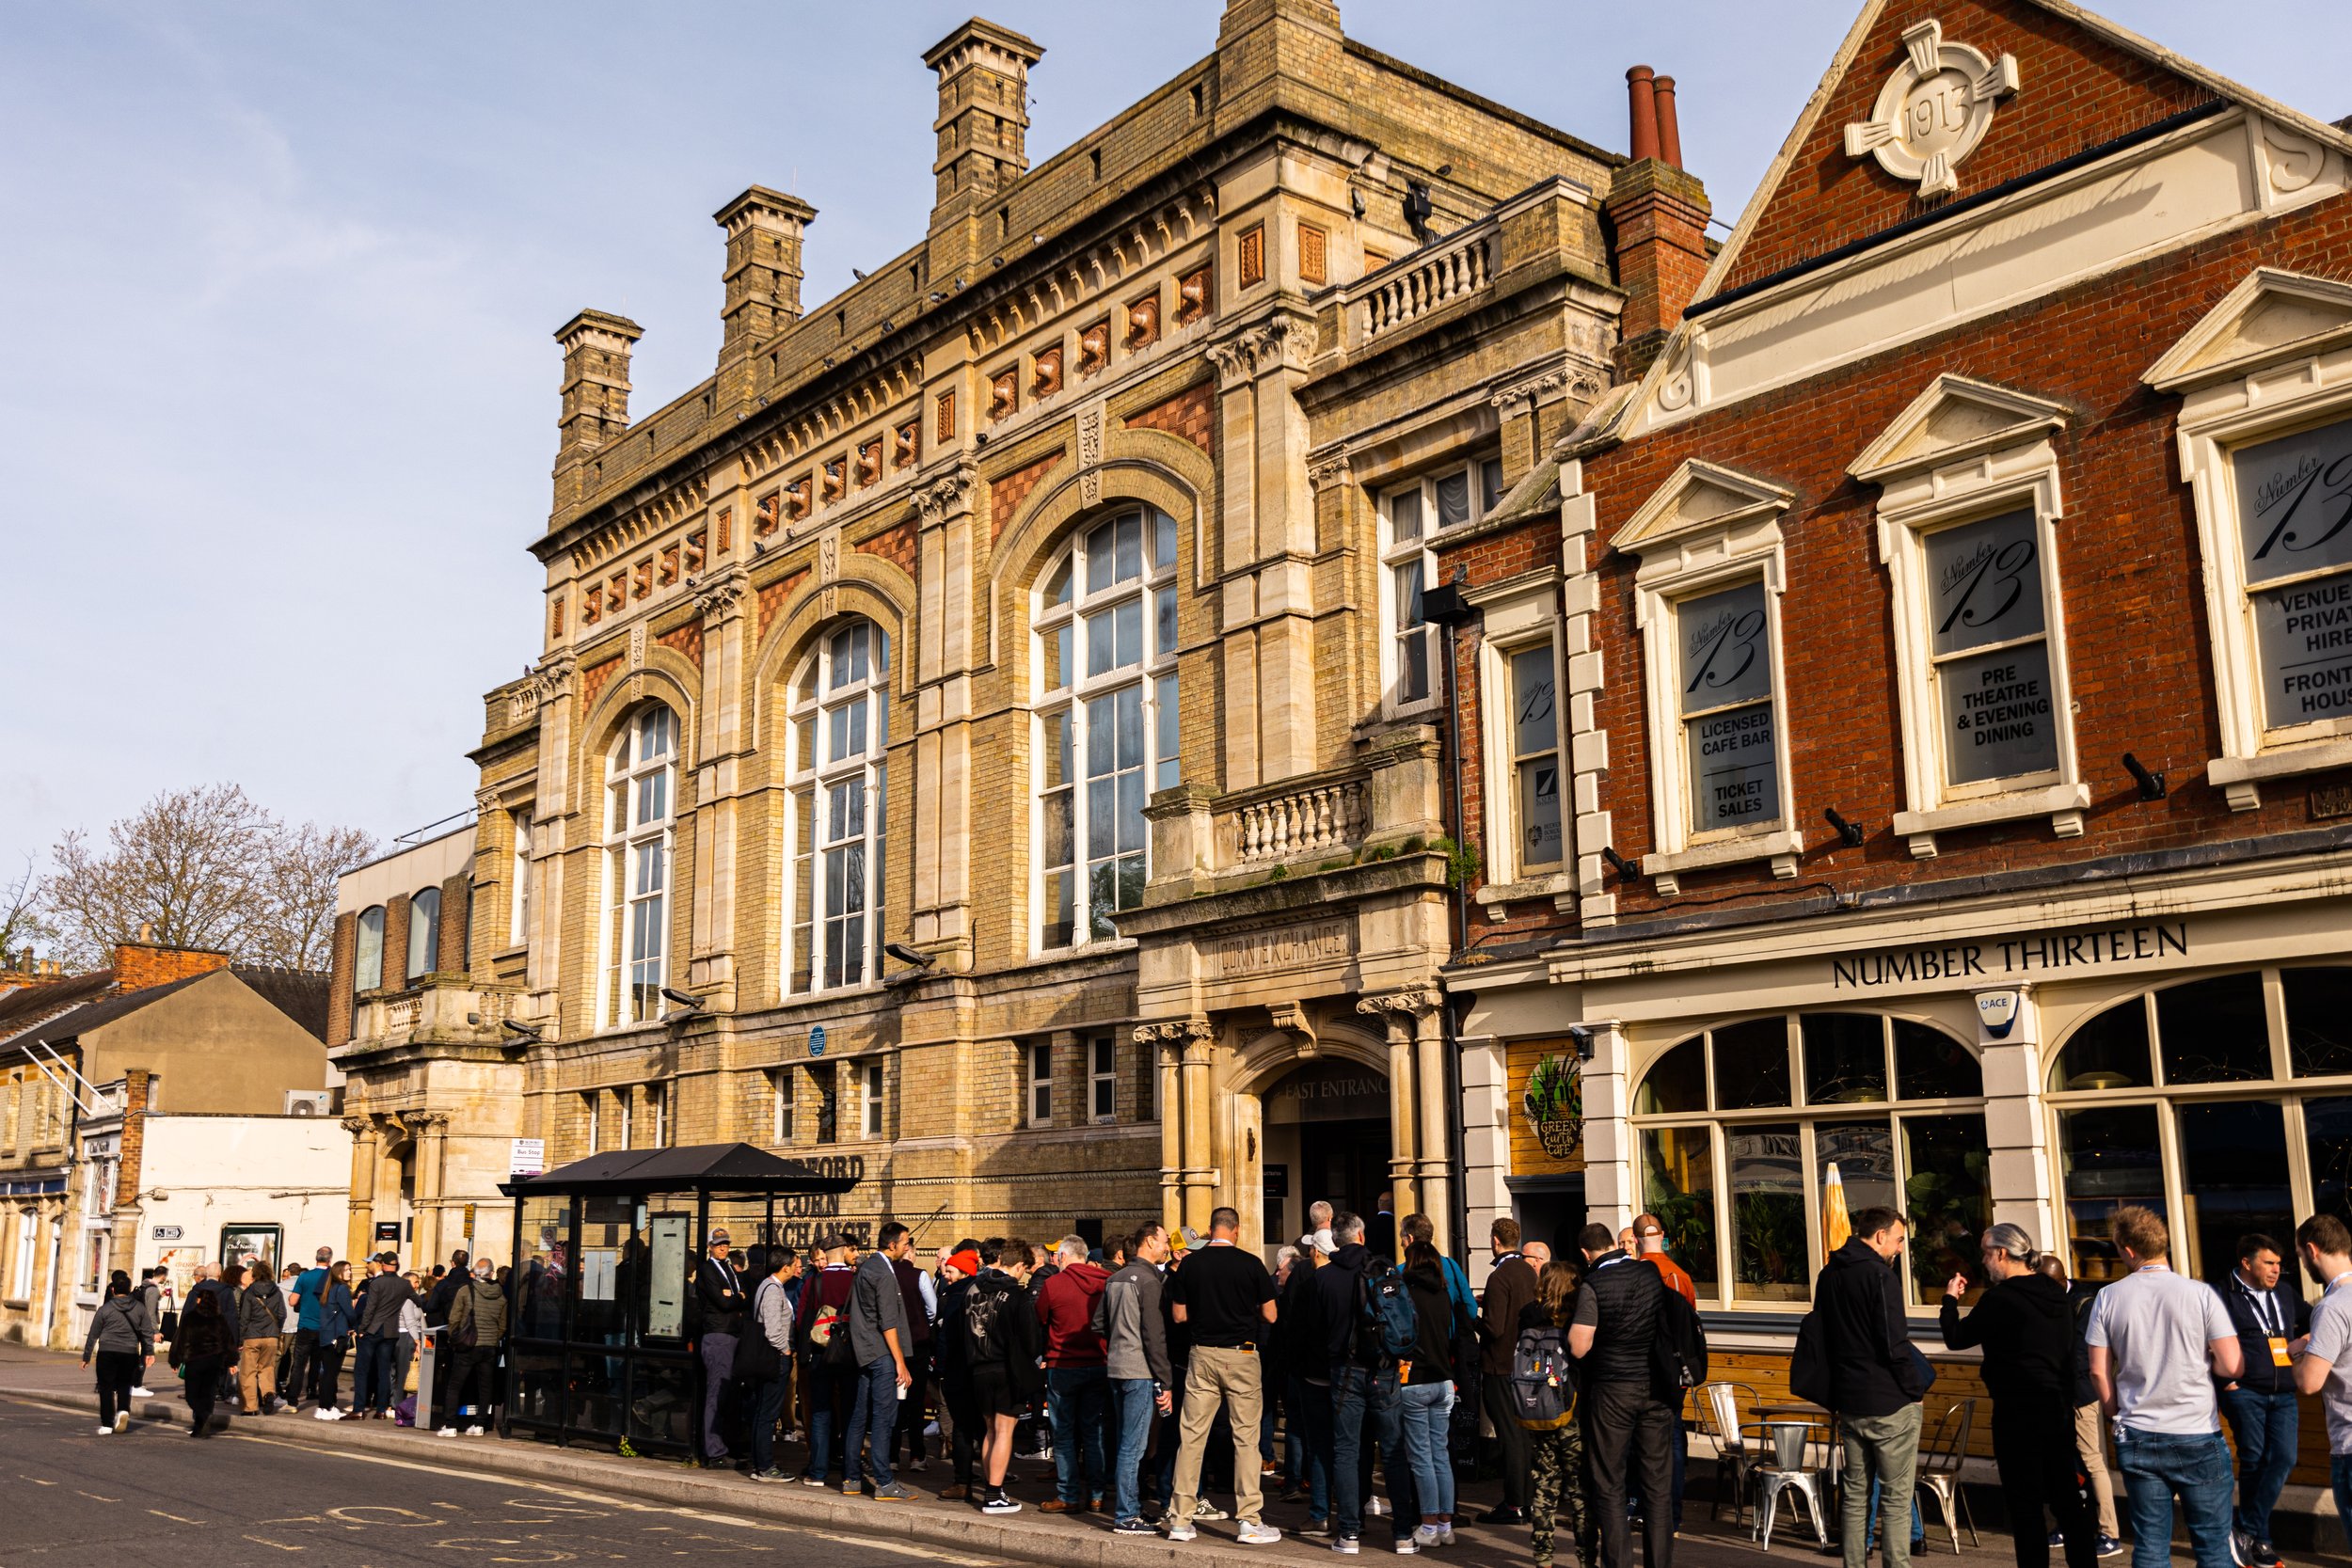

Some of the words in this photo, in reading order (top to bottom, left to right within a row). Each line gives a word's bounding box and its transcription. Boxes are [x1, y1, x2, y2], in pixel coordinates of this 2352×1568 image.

[1904, 85, 1971, 144] 1913
[2253, 454, 2319, 512] Number
[2252, 452, 2352, 561] 13
[1941, 541, 1994, 592] Number
[1938, 540, 2036, 634] 13
[2280, 584, 2350, 612] VENUE
[1689, 610, 1733, 654] Number
[2306, 627, 2352, 652] HIRE
[1686, 610, 1766, 693] 13
[1981, 665, 2016, 686] PRE
[2284, 666, 2352, 694] FRONT
[1963, 680, 2039, 709] THEATRE
[1701, 712, 1769, 739] LICENSED
[1957, 714, 1971, 730] &
[1975, 698, 2049, 727] EVENING
[1701, 735, 1739, 756] CAFÉ
[1741, 730, 1771, 749] BAR
[1974, 721, 2034, 746] DINING
[1715, 779, 1763, 800] TICKET
[1718, 798, 1763, 818] SALES
[1222, 938, 1255, 970] CORN
[1835, 945, 1986, 989] NUMBER
[1996, 923, 2187, 972] THIRTEEN
[1989, 998, 2008, 1007] ACE
[1285, 1082, 1316, 1099] EAST
[1321, 1077, 1389, 1098] ENTRANC
[1540, 1119, 1577, 1132] GREEN
[784, 1193, 839, 1215] CORN
